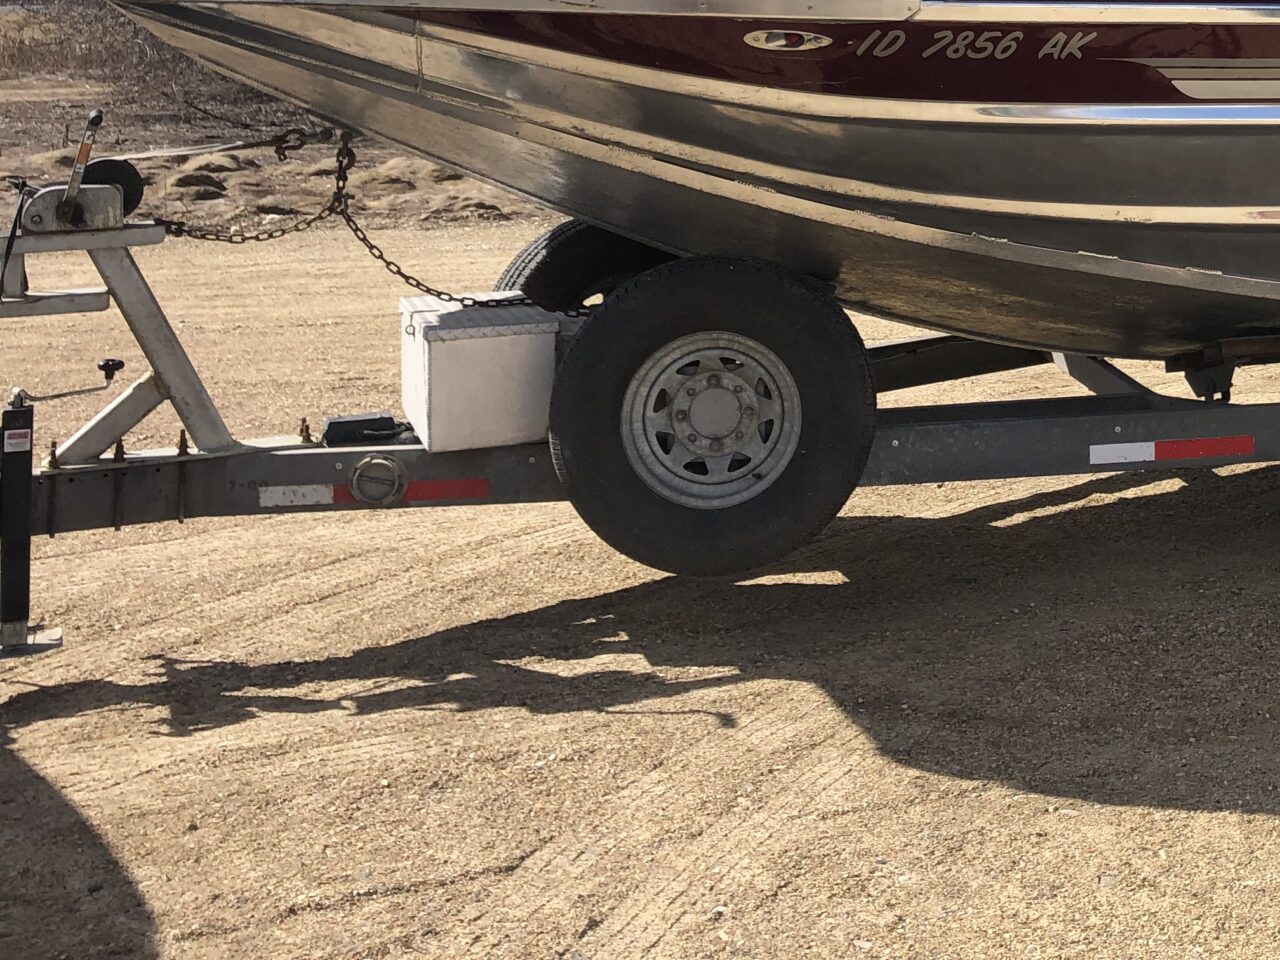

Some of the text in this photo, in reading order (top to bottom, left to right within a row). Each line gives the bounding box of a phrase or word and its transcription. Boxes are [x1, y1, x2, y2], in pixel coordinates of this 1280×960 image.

[856, 29, 1098, 60] ID 7856 AK
